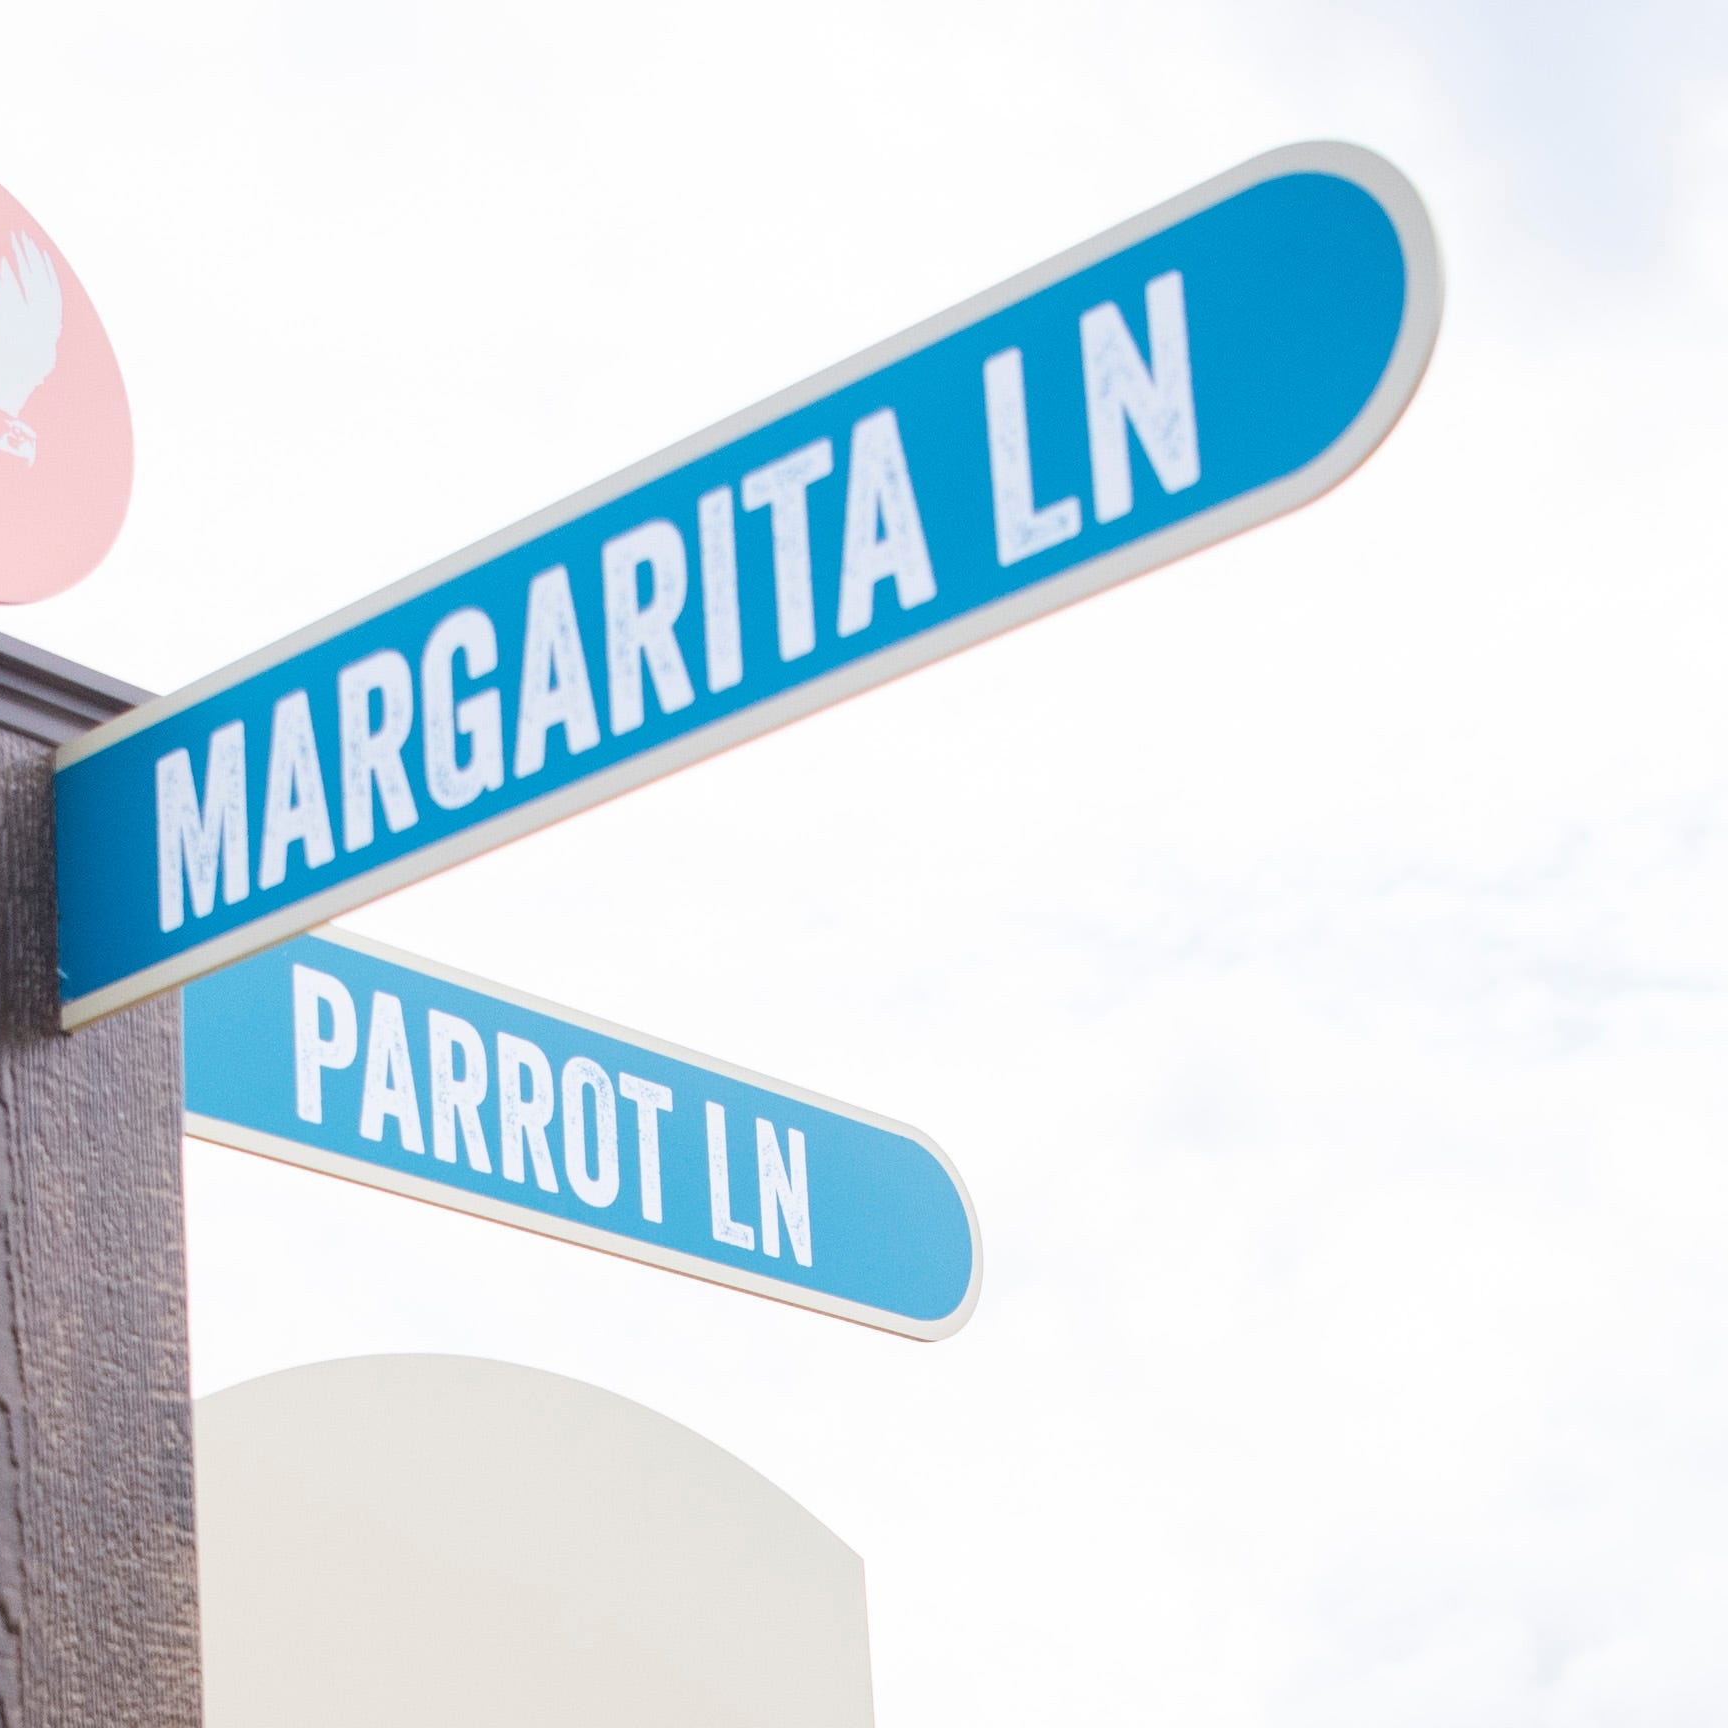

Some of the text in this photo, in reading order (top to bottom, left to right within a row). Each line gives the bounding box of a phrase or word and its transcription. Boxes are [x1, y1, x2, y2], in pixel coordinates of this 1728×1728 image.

[154, 270, 1201, 934] MARGARITA LN
[292, 963, 813, 1268] PARROT LN
